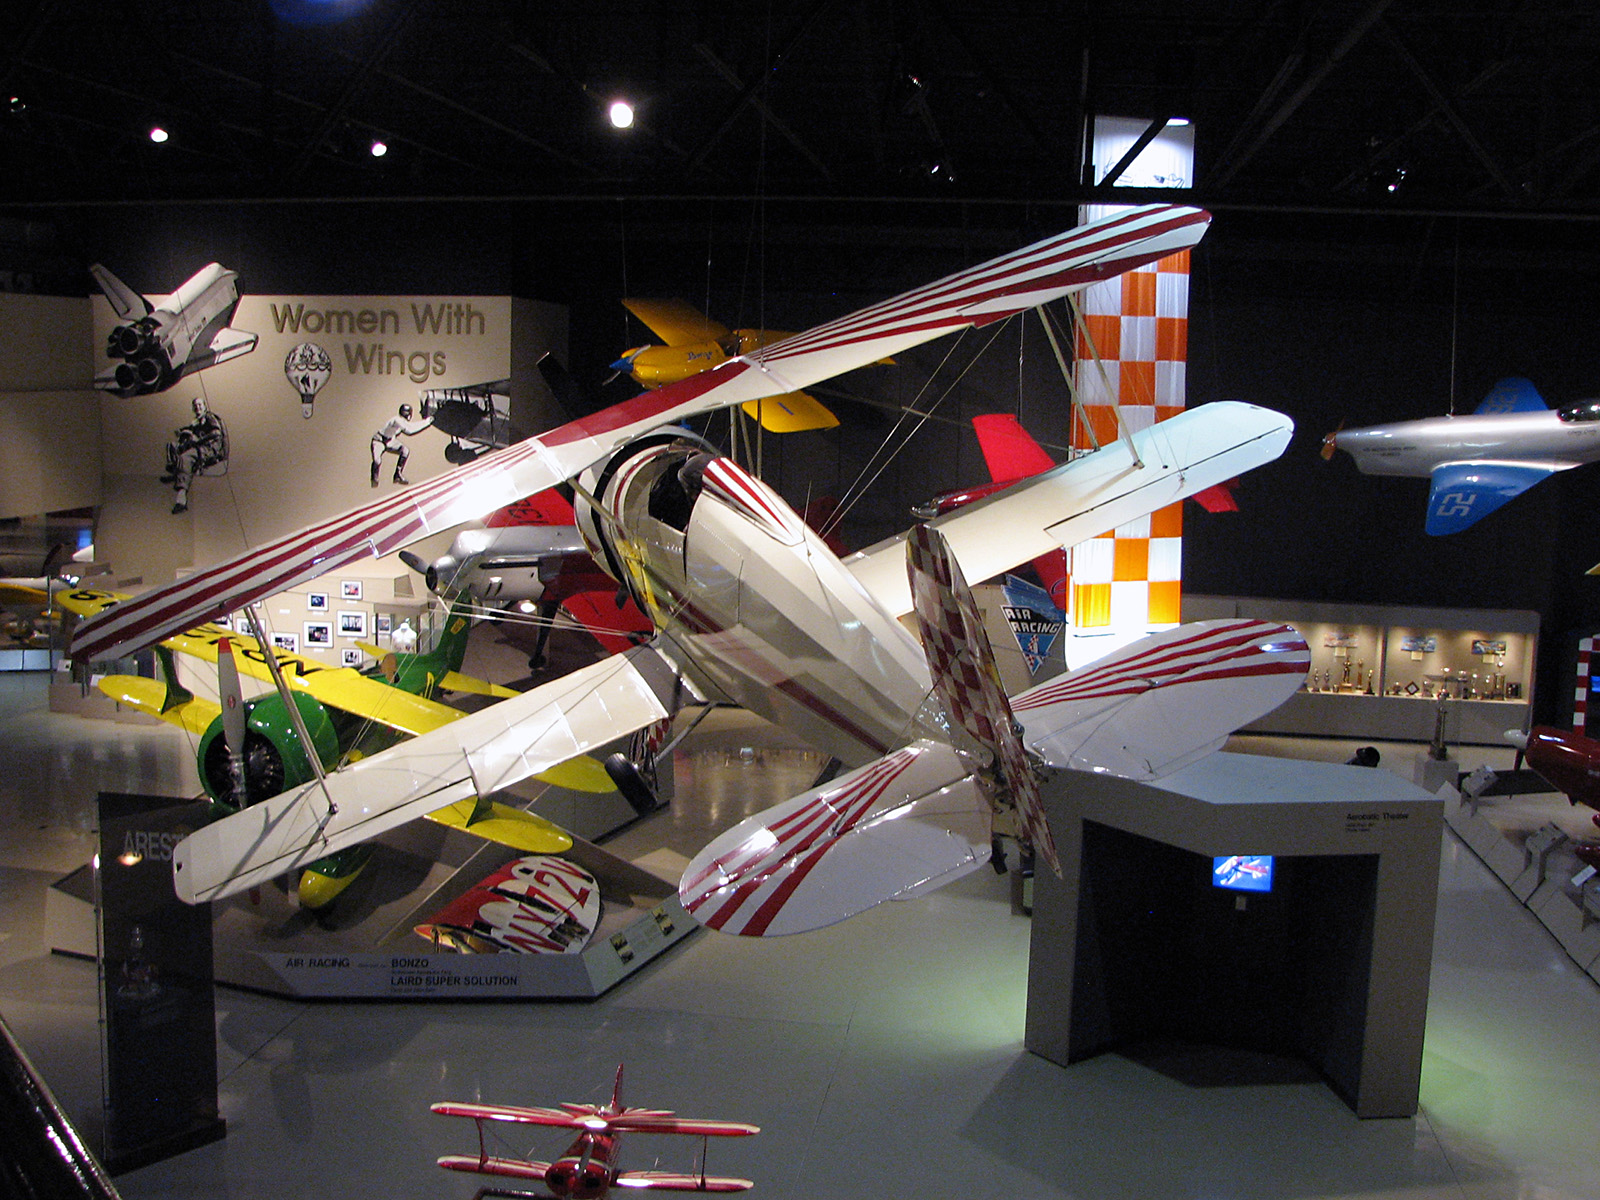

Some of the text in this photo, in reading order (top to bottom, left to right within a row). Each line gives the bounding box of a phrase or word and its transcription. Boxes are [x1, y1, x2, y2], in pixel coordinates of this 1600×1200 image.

[269, 302, 485, 335] Women With
[343, 342, 447, 383] Wings
[286, 958, 304, 968] AIR
[309, 957, 350, 968] RACING
[391, 958, 429, 968] BONZO
[391, 975, 518, 986] LAIRD SUPER SOLUTION
